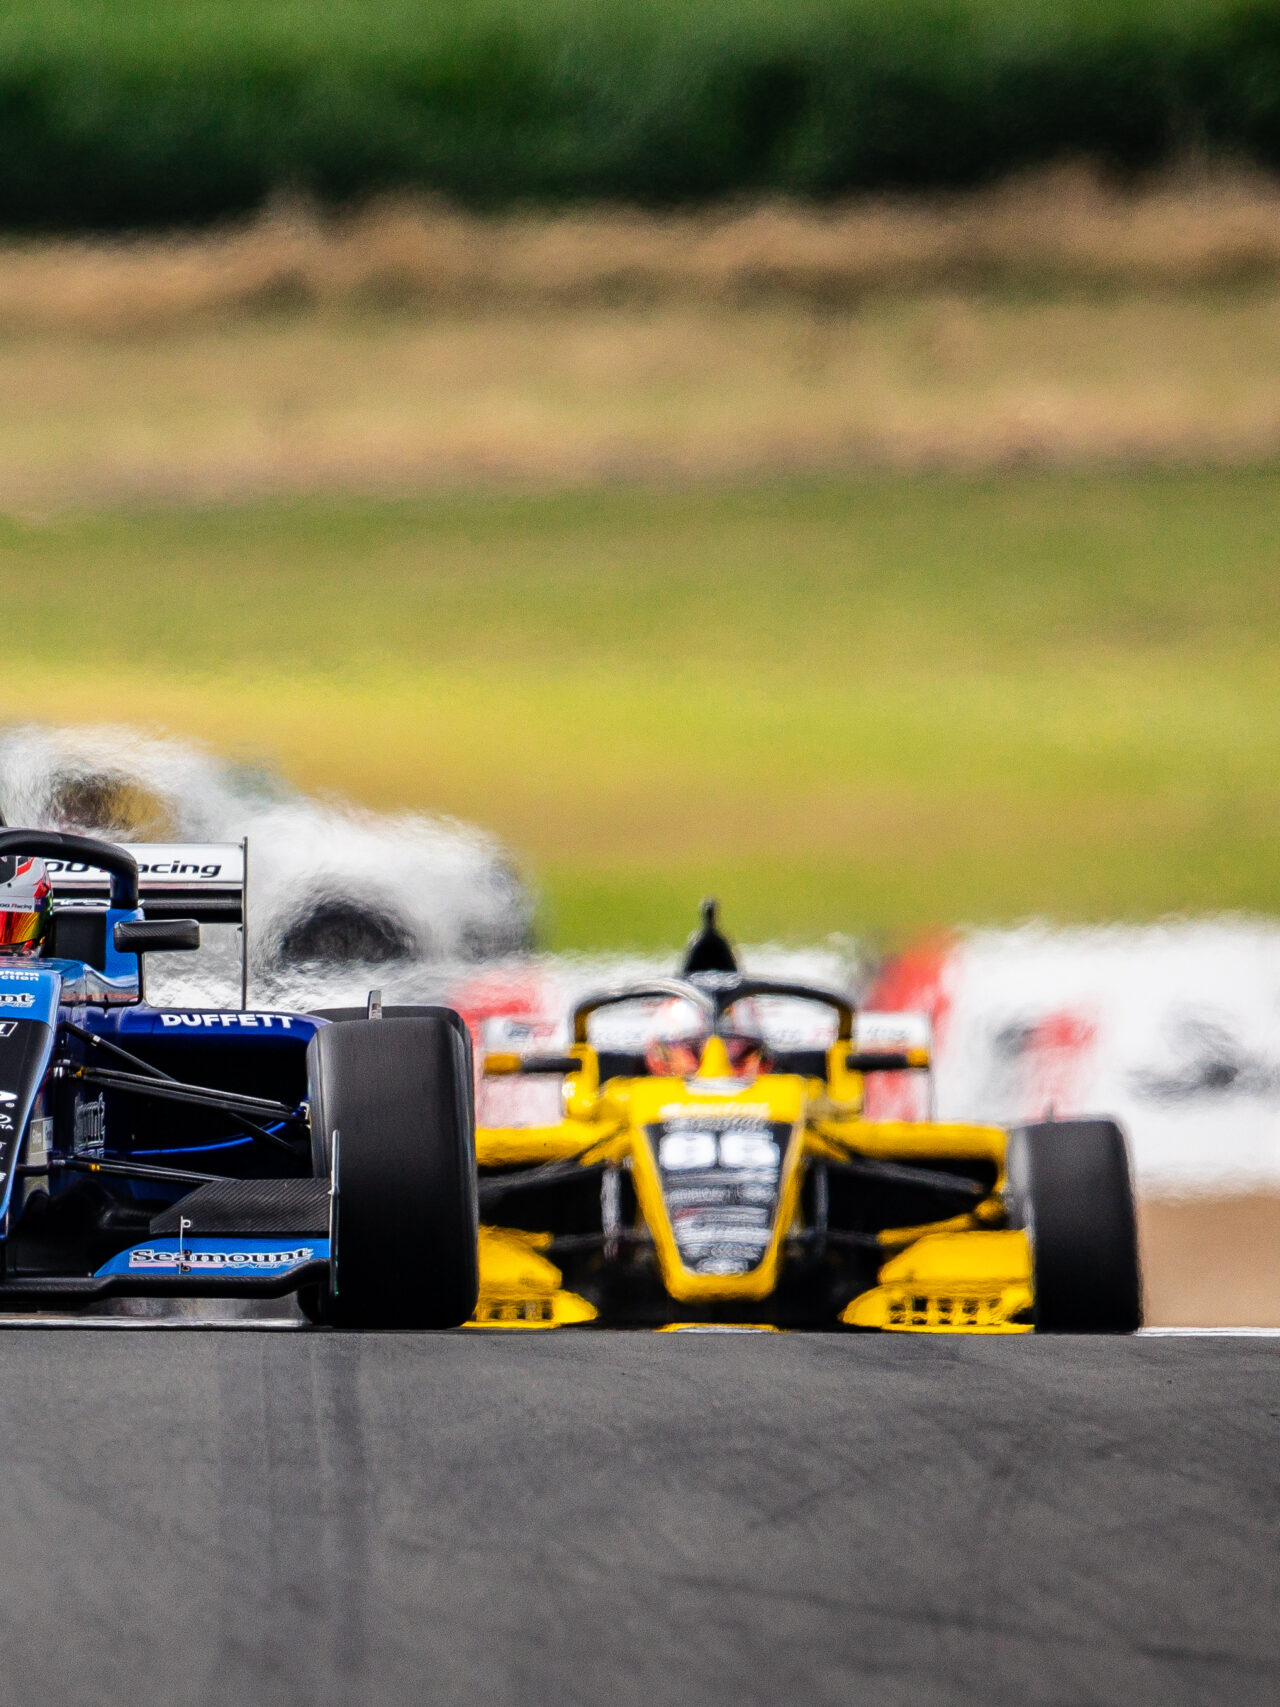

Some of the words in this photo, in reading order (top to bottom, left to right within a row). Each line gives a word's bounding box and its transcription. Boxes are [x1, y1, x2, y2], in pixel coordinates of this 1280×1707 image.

[137, 860, 223, 878] acing
[160, 1014, 294, 1029] DUFFETT
[129, 1247, 314, 1263] Seamount
